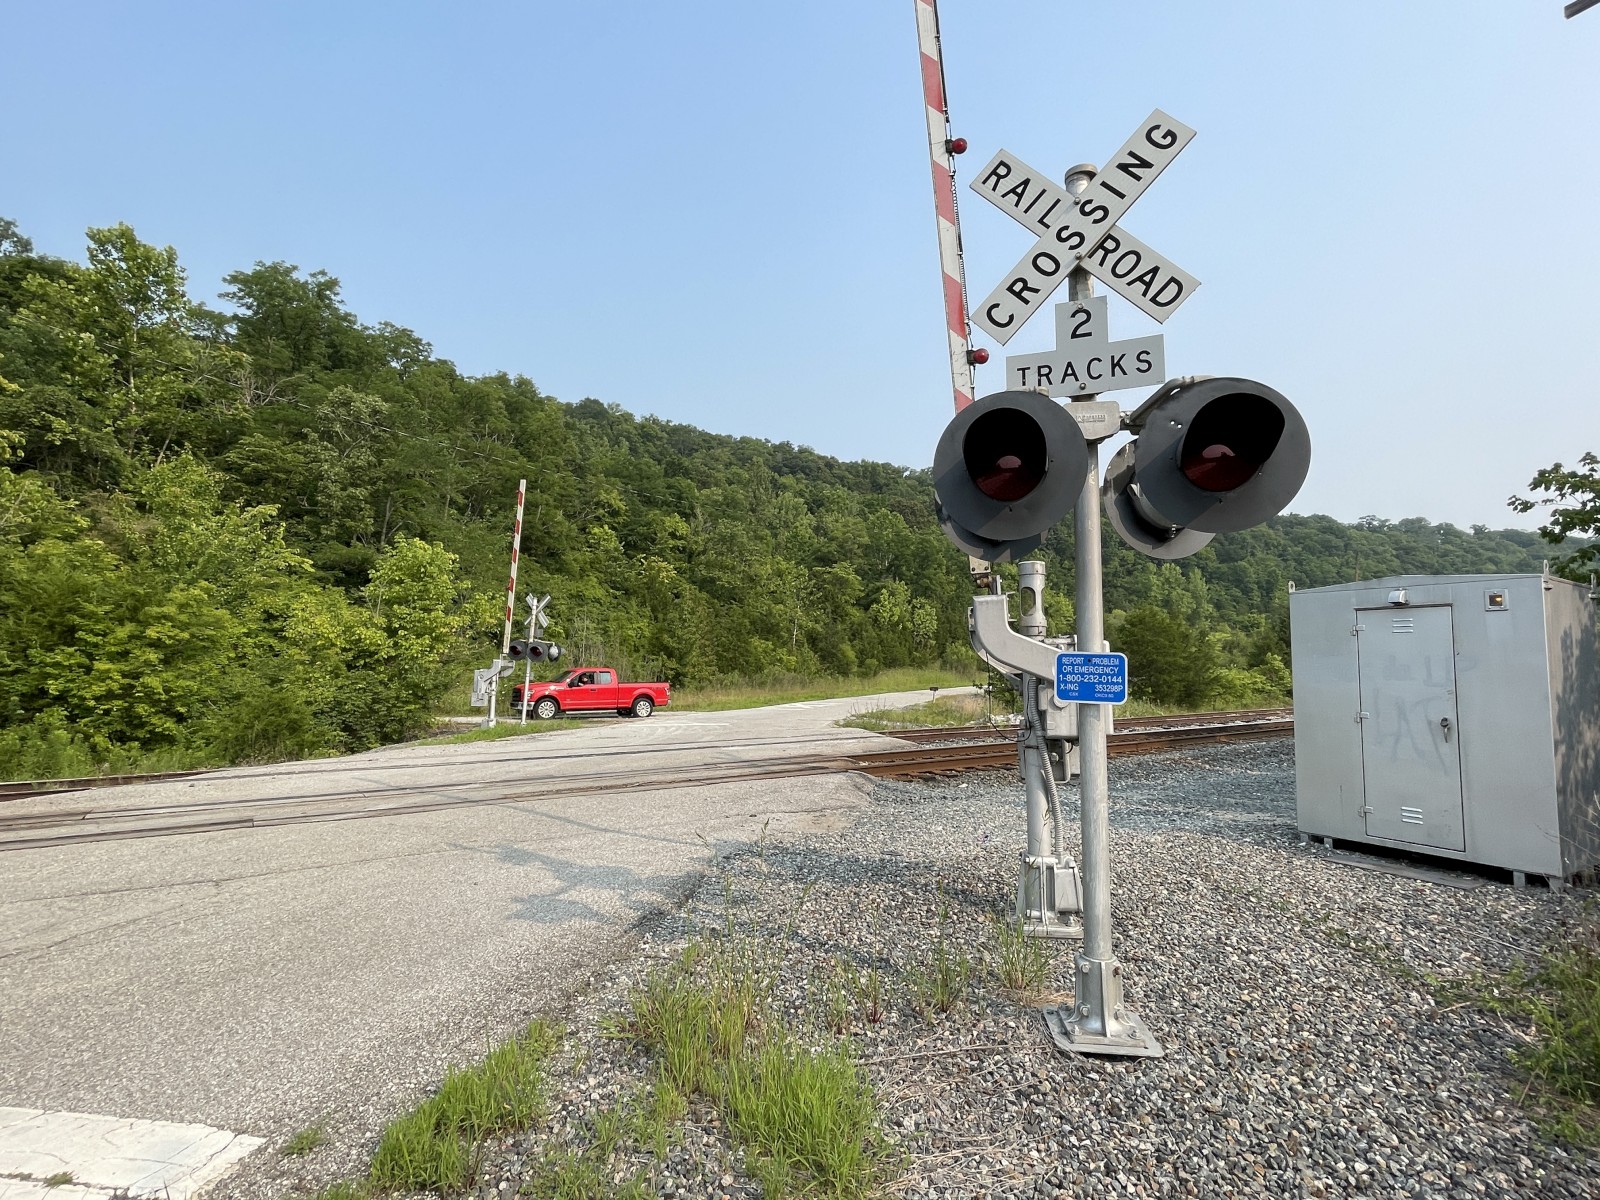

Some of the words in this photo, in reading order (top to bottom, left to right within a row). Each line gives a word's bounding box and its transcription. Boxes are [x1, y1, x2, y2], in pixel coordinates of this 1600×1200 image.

[981, 160, 1062, 229] RAIL
[1087, 233, 1184, 308] ROAD
[986, 123, 1178, 329] CROSSING
[1070, 308, 1093, 339] 2
[1017, 350, 1153, 387] TRACKS
[1062, 657, 1084, 665] REPORT
[1092, 657, 1119, 665] PROBLEM
[1074, 666, 1119, 674] EMERGENCY
[1059, 674, 1122, 683] 1-800-232-0144
[1059, 683, 1079, 691] X-ING
[1094, 684, 1123, 692] 353298P
